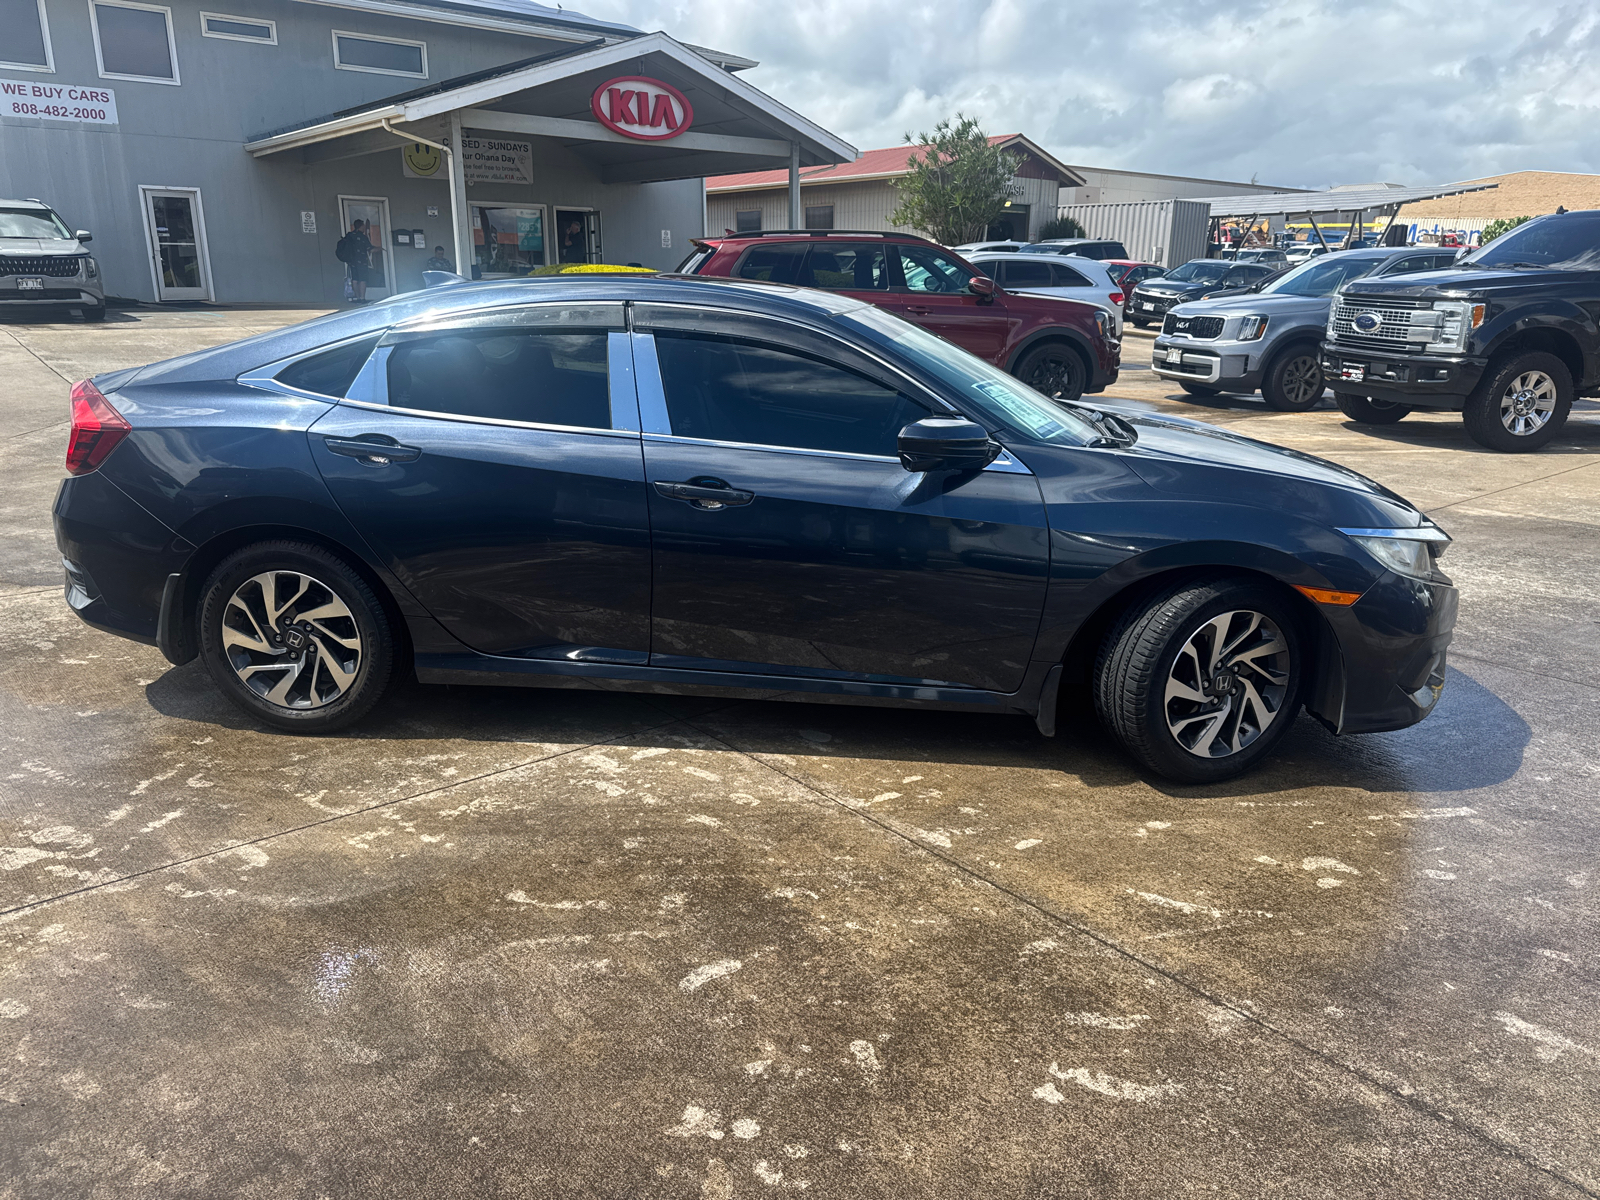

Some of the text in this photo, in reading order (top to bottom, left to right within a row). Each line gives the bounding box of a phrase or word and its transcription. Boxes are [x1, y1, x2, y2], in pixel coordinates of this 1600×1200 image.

[1, 82, 110, 103] WE BUY CARS
[12, 102, 106, 120] 808-482-2000
[607, 88, 679, 129] KIA
[442, 137, 480, 149] CSED
[487, 141, 529, 152] SUNDAYS
[474, 152, 499, 162] Ohana
[501, 153, 516, 164] Day
[203, 585, 220, 634] MICHELIN
